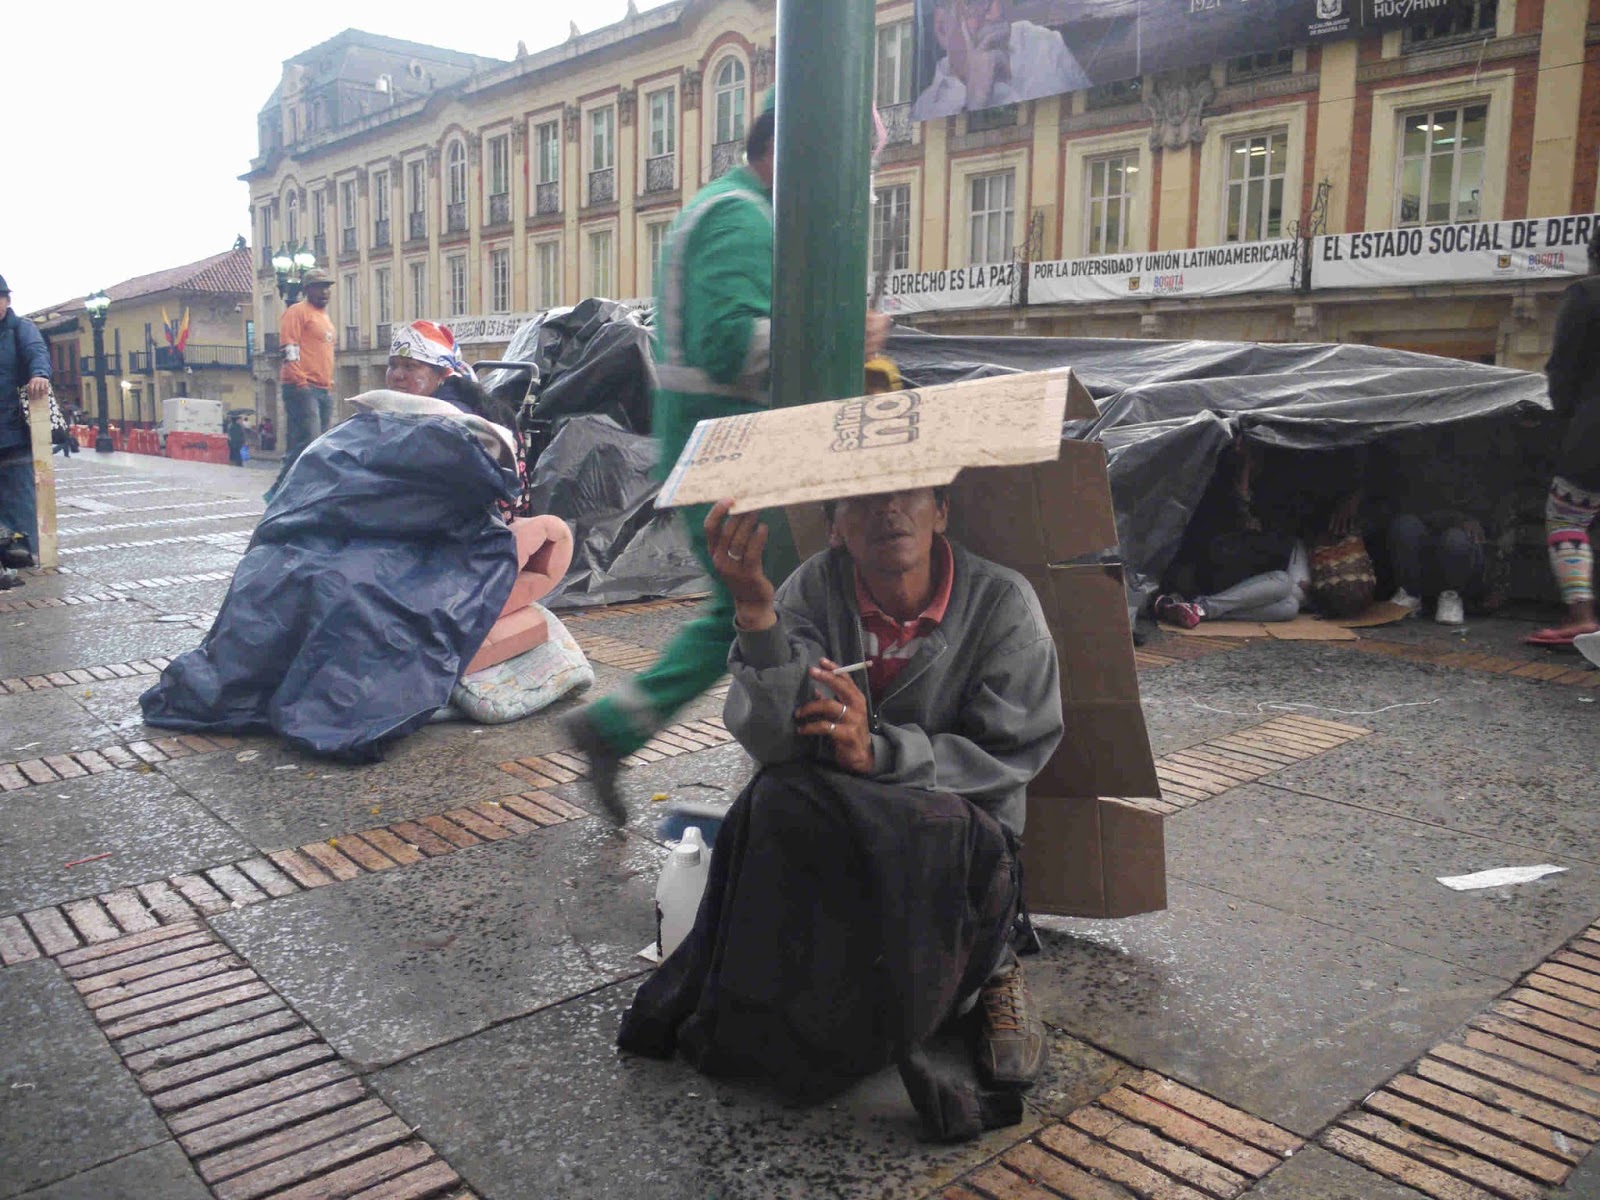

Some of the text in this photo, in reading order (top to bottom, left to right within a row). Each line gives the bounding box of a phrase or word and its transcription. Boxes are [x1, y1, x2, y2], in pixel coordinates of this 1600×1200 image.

[1323, 236, 1343, 261] EL
[1350, 229, 1423, 259] ESTADO
[1429, 222, 1503, 254] SOCIAL
[1511, 220, 1538, 248] DE
[892, 271, 946, 295] DERECHO
[950, 269, 965, 291] ES
[969, 267, 985, 289] LA
[990, 263, 1014, 287] PAZ
[1034, 263, 1054, 279] POR
[1056, 262, 1069, 277] LA
[1071, 258, 1134, 276] DIVERSIDAD
[1137, 256, 1143, 272] Y
[1184, 242, 1298, 268] LATINOAMERICANA
